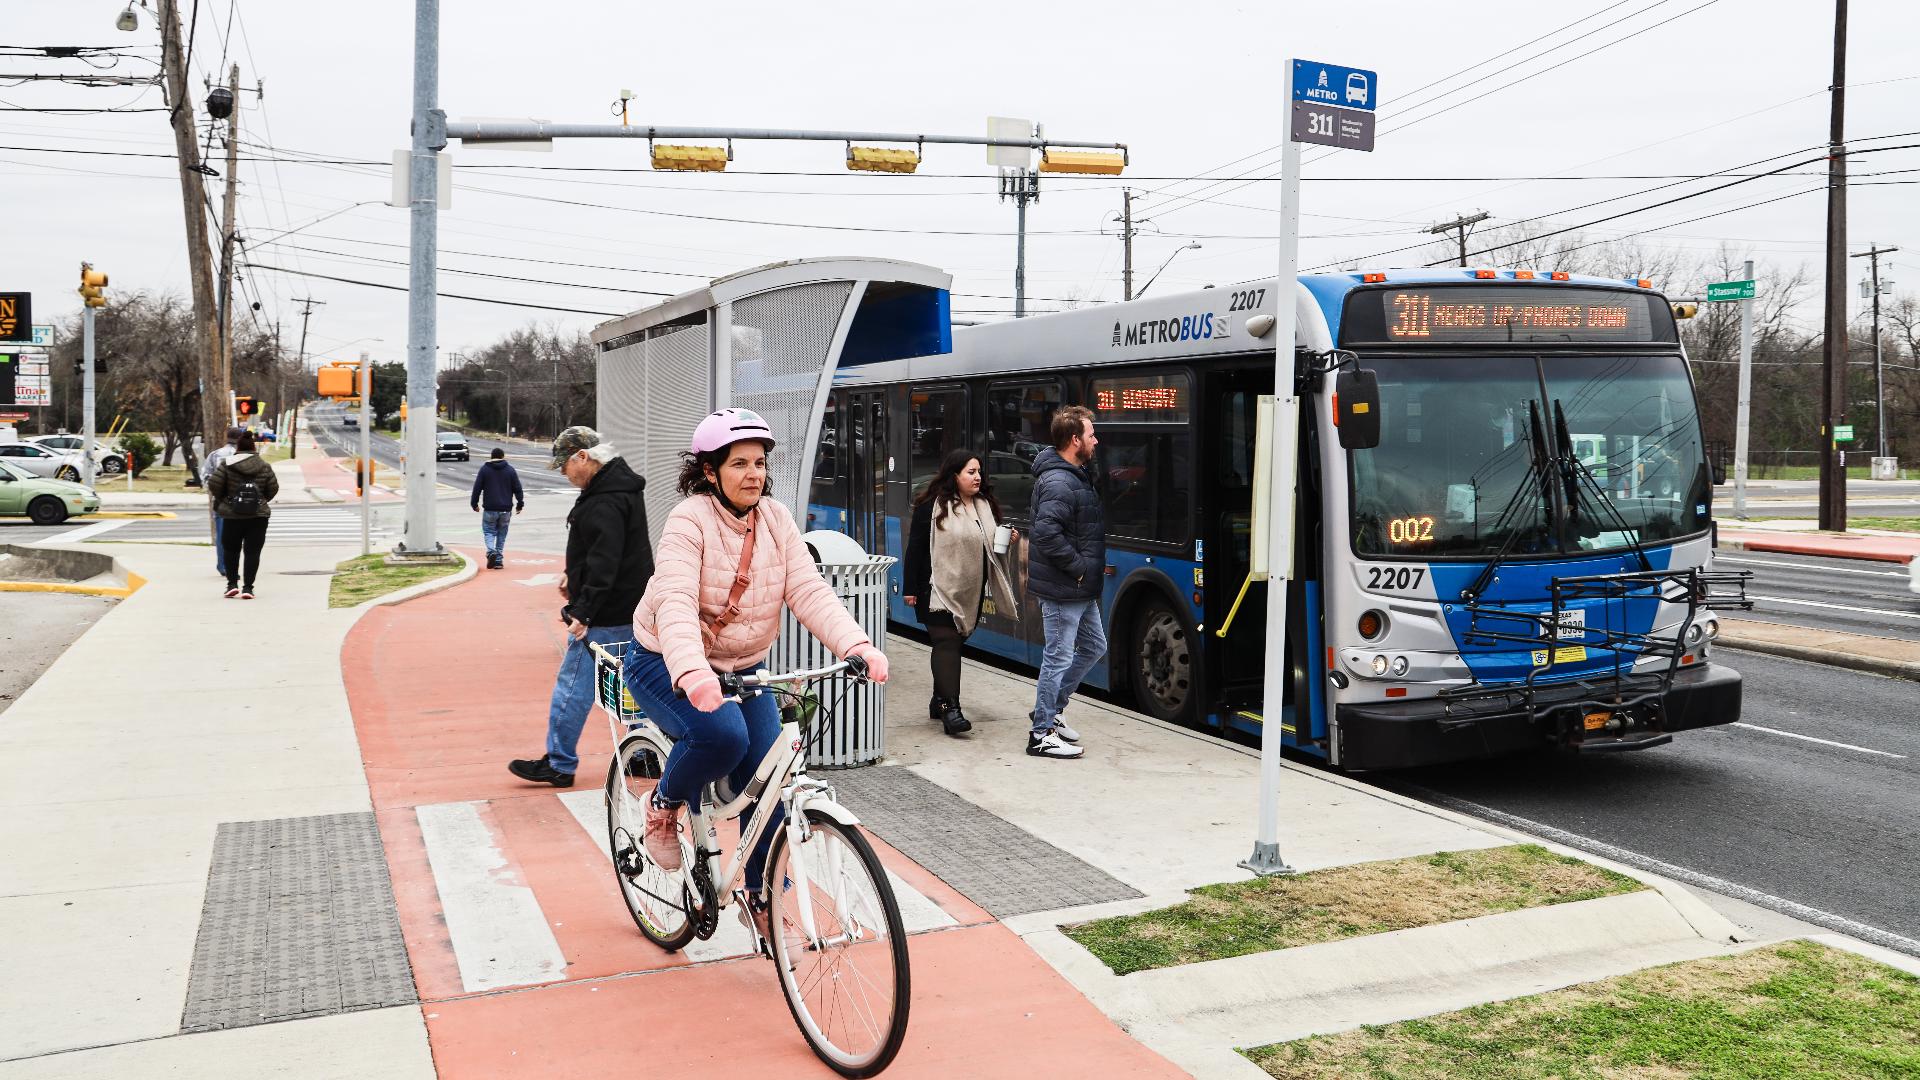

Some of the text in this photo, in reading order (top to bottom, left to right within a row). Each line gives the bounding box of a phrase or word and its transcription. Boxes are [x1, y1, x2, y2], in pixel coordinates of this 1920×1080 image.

[1306, 88, 1337, 100] METRO
[1308, 112, 1333, 136] 311
[1229, 289, 1265, 311] 2207
[1392, 294, 1430, 336] 311
[1434, 305, 1486, 326] HEADS
[1588, 306, 1627, 327] DOWN
[1124, 313, 1213, 346] METROBUS
[1390, 517, 1434, 542] 002
[1367, 567, 1425, 589] 2207
